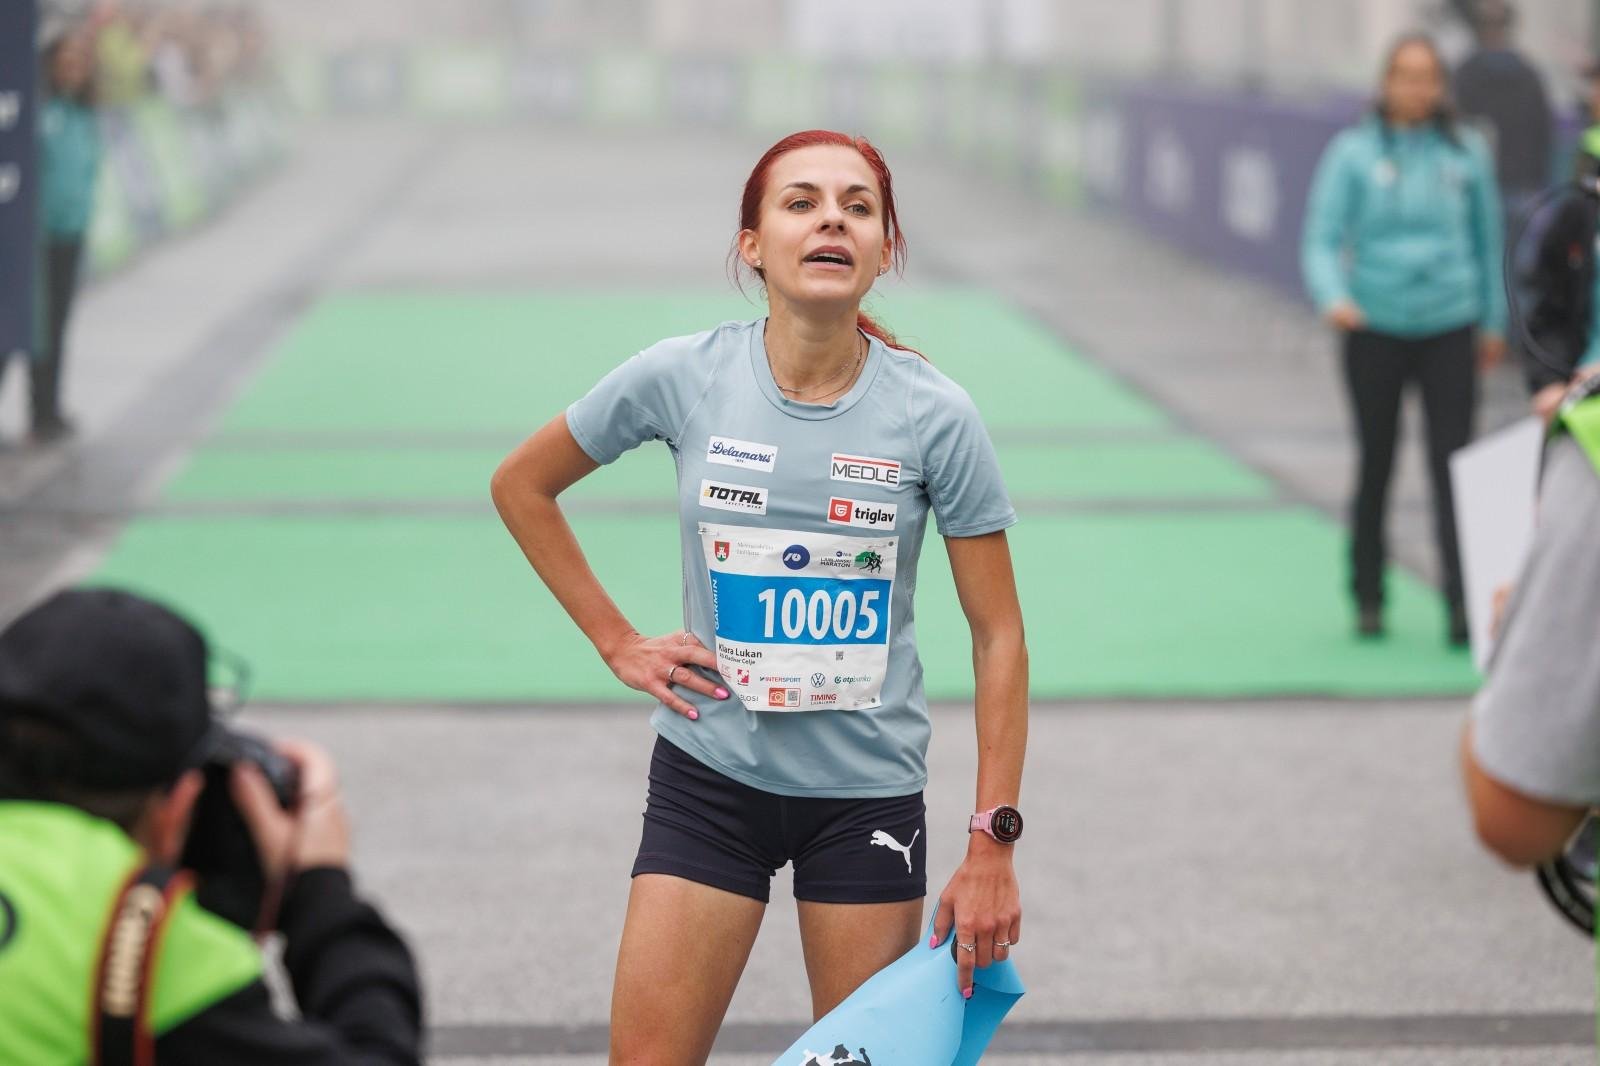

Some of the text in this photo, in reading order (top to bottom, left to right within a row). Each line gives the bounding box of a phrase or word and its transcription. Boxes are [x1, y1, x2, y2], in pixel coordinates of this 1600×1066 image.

[709, 441, 771, 463] Delamaris
[832, 463, 898, 484] MEDLE
[709, 485, 763, 506] TOTAL
[855, 507, 895, 525] triglav
[758, 588, 879, 640] 10005
[735, 647, 763, 659] Lukan
[810, 693, 837, 701] TIMING
